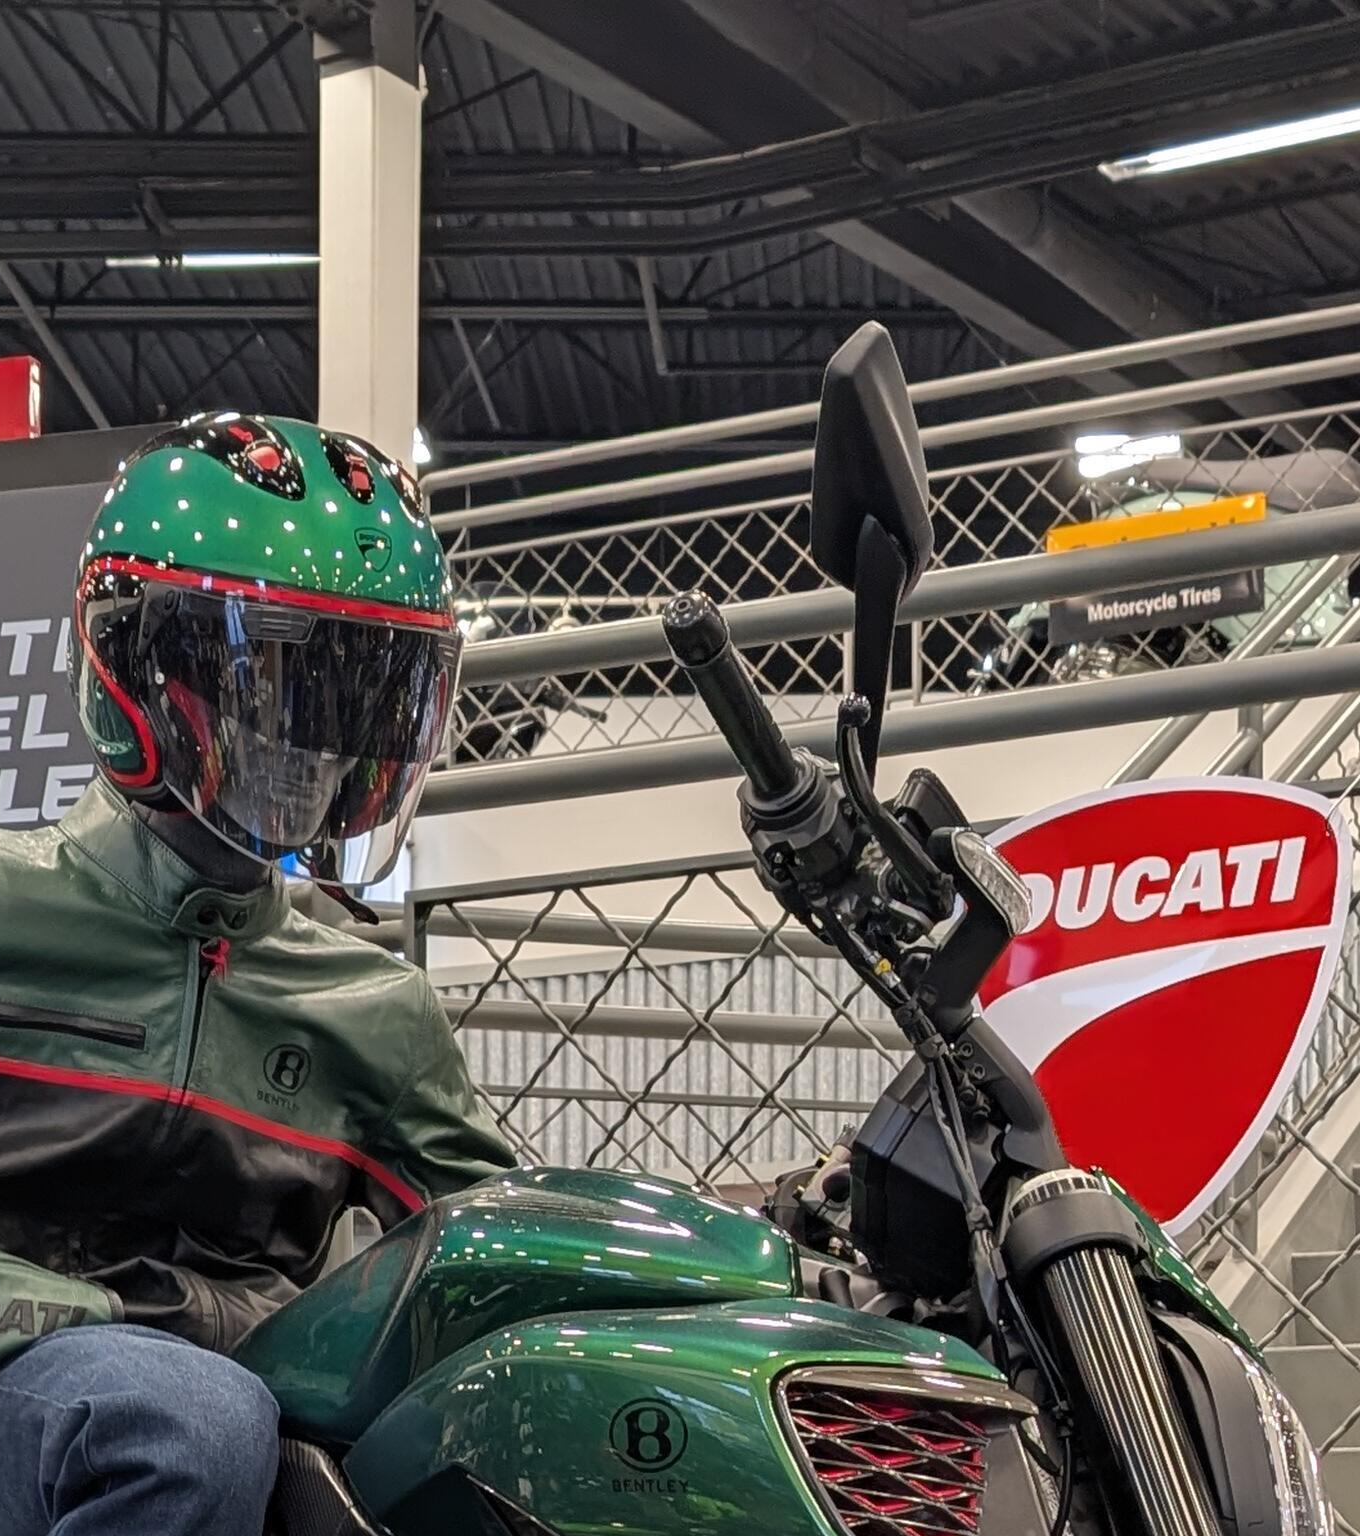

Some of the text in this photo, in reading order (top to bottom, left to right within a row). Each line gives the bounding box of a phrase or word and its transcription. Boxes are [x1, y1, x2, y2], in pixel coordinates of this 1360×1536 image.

[1087, 586, 1222, 622] Motorcycle Tires
[611, 1479, 689, 1493] BENTLEY
